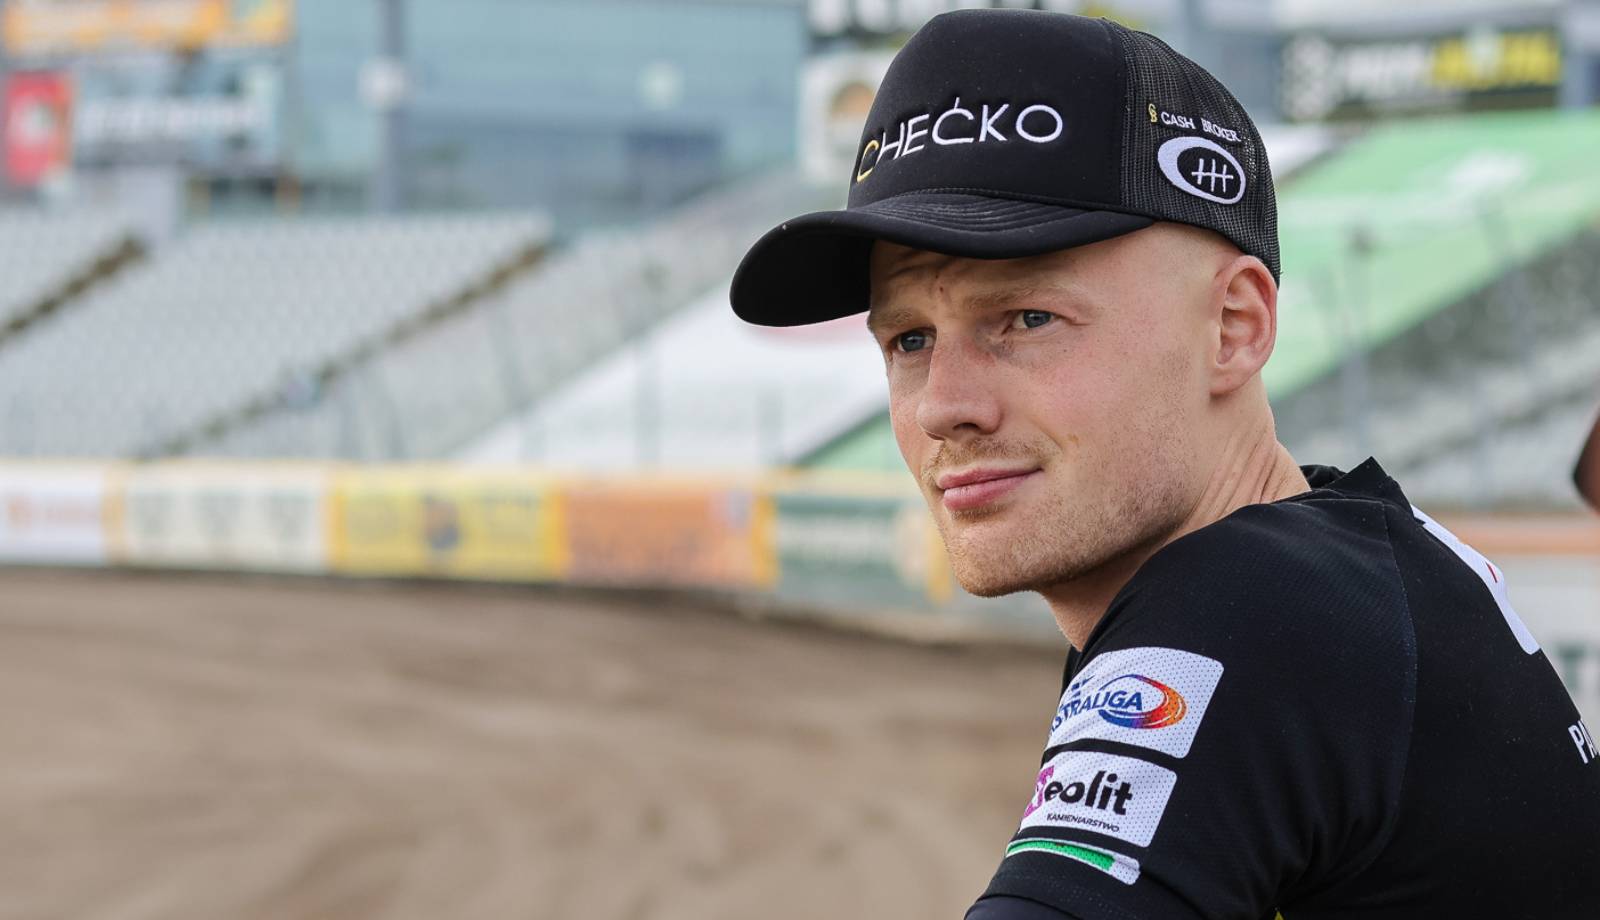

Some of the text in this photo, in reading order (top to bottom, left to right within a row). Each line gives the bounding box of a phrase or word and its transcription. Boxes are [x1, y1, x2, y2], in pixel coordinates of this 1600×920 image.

[1158, 110, 1197, 130] CASH
[1200, 116, 1242, 142] BROKER
[1046, 813, 1120, 833] KAMIENIARSTWO
